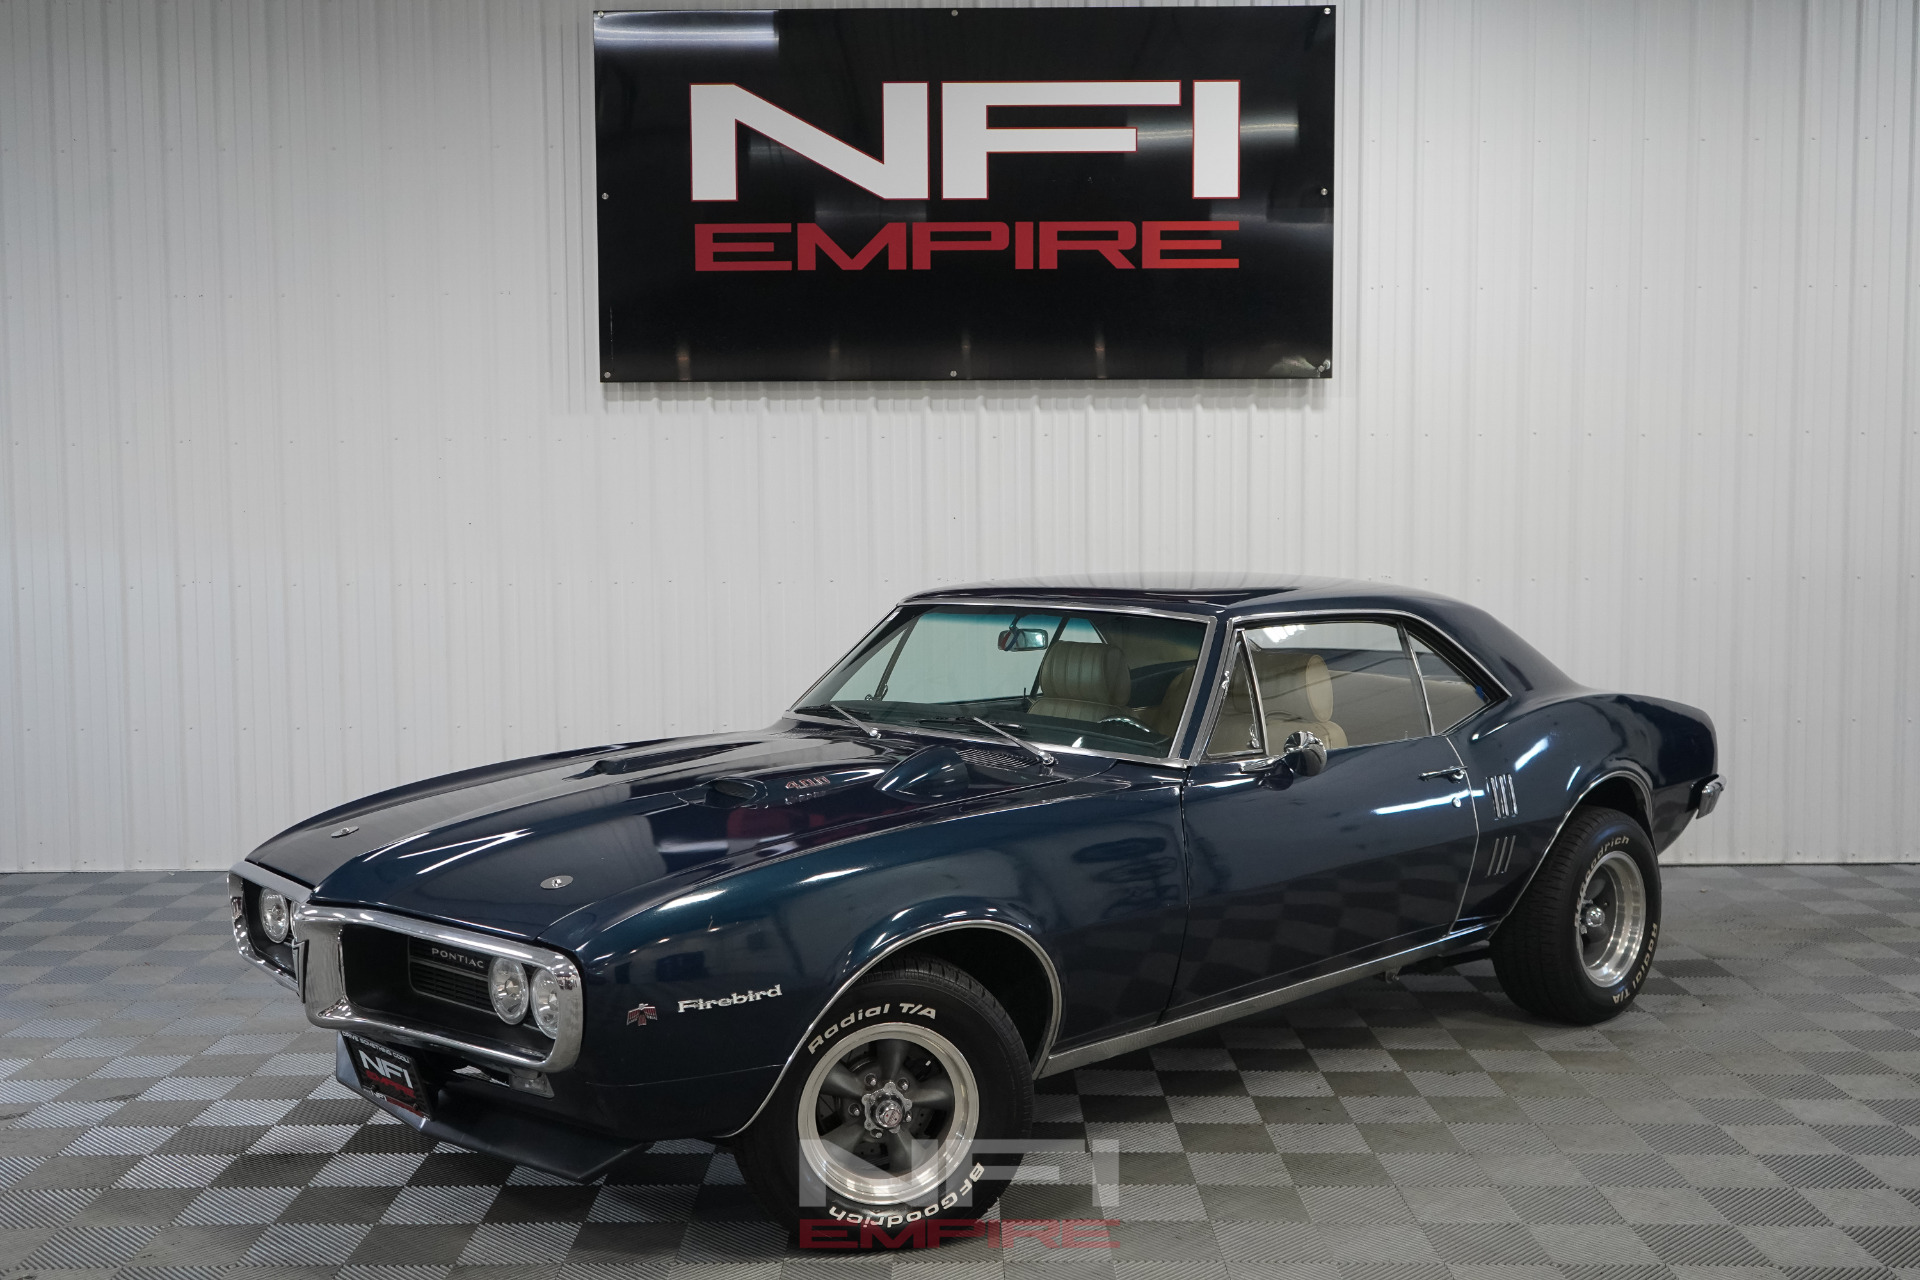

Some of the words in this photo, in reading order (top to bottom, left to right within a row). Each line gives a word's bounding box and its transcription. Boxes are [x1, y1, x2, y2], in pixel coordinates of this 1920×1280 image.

[689, 79, 1241, 201] NFI
[694, 220, 1240, 272] EMPIRE
[431, 947, 485, 969] PONTIAC
[1632, 922, 1658, 989] Radial
[677, 983, 783, 1013] Firebird
[1612, 988, 1631, 1004] T/A
[807, 1003, 891, 1055] Radial
[899, 1002, 937, 1020] T/A
[358, 1049, 414, 1090] NFI
[828, 1162, 985, 1228] BFGoodrich
